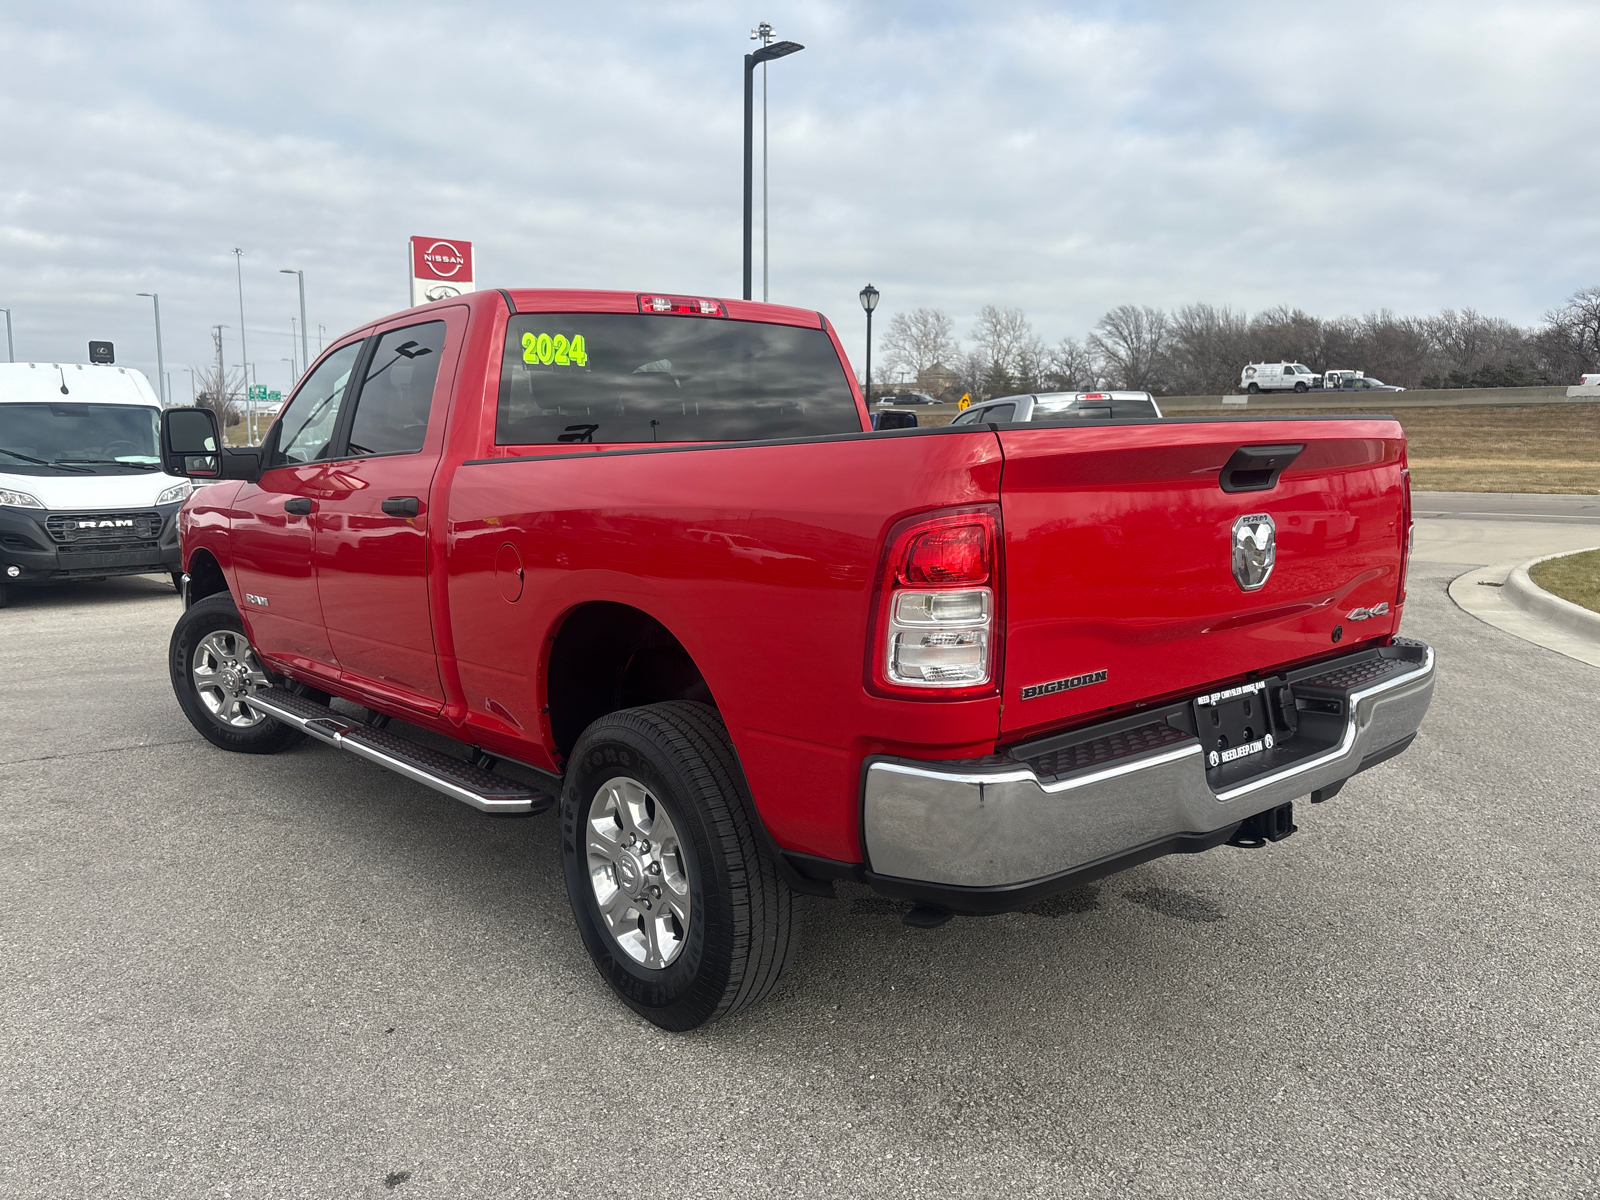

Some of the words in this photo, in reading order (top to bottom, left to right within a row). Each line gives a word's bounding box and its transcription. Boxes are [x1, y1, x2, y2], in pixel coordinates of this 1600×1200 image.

[424, 254, 464, 264] NISSAN
[522, 332, 587, 367] 2024
[79, 520, 133, 528] RAM
[1243, 515, 1267, 523] RAM
[246, 593, 269, 606] RAM
[1022, 669, 1108, 700] BIGHORN
[1198, 695, 1210, 705] REED
[1210, 692, 1221, 702] JEEP
[1221, 687, 1242, 699] CHRYSLER
[1242, 683, 1256, 693] DODGE
[1255, 681, 1266, 690] RAM
[1222, 741, 1263, 763] REEDJEEP.COM
